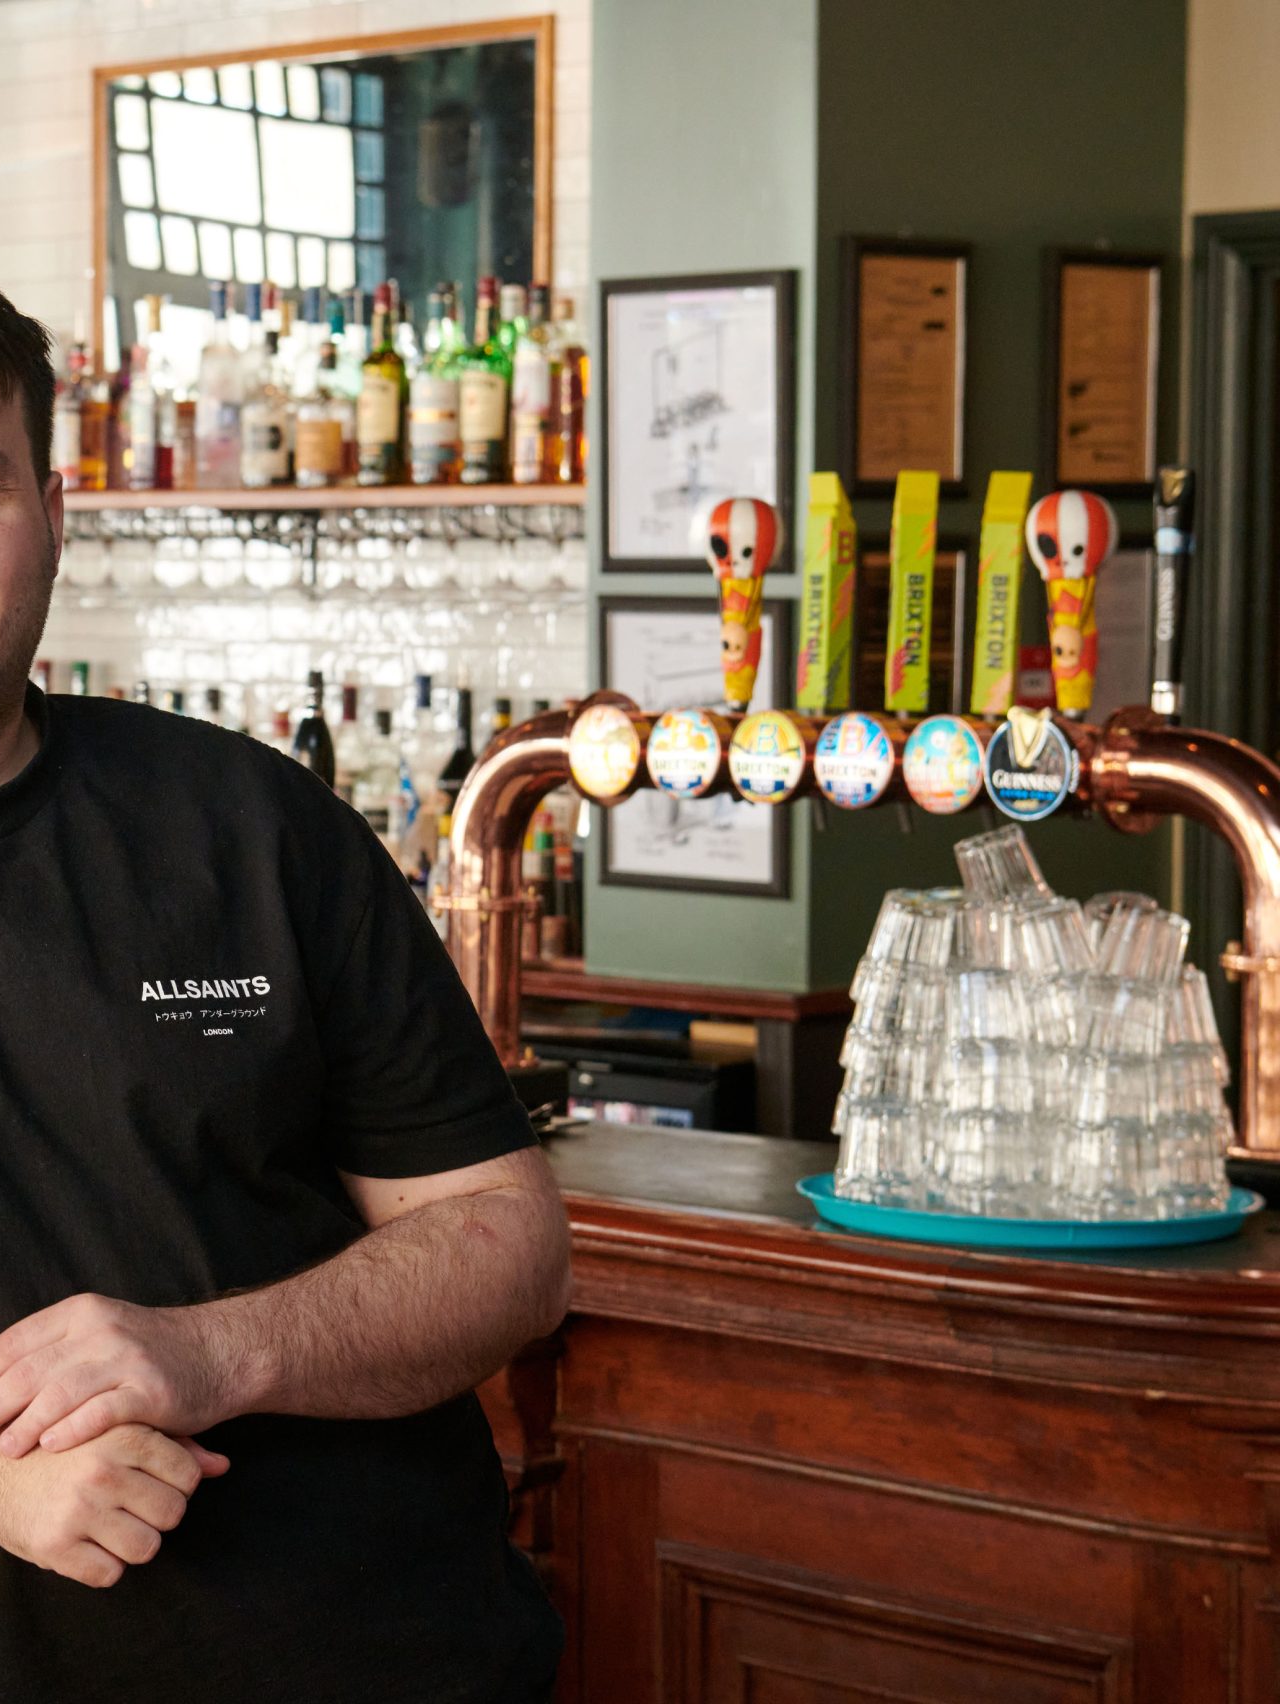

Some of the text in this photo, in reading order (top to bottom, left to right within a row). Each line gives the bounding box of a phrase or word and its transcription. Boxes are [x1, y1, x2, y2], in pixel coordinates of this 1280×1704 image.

[836, 530, 854, 565] B
[808, 573, 824, 665] BRIXTON
[903, 573, 925, 667] BRIXTON
[987, 574, 1009, 669] BRIXTON
[992, 769, 1063, 793] GUINNESS
[141, 975, 271, 1002] ALLSAINTS
[154, 1006, 267, 1022] トウキョウ アンダーグラウンド
[203, 1028, 234, 1036] LONDON
